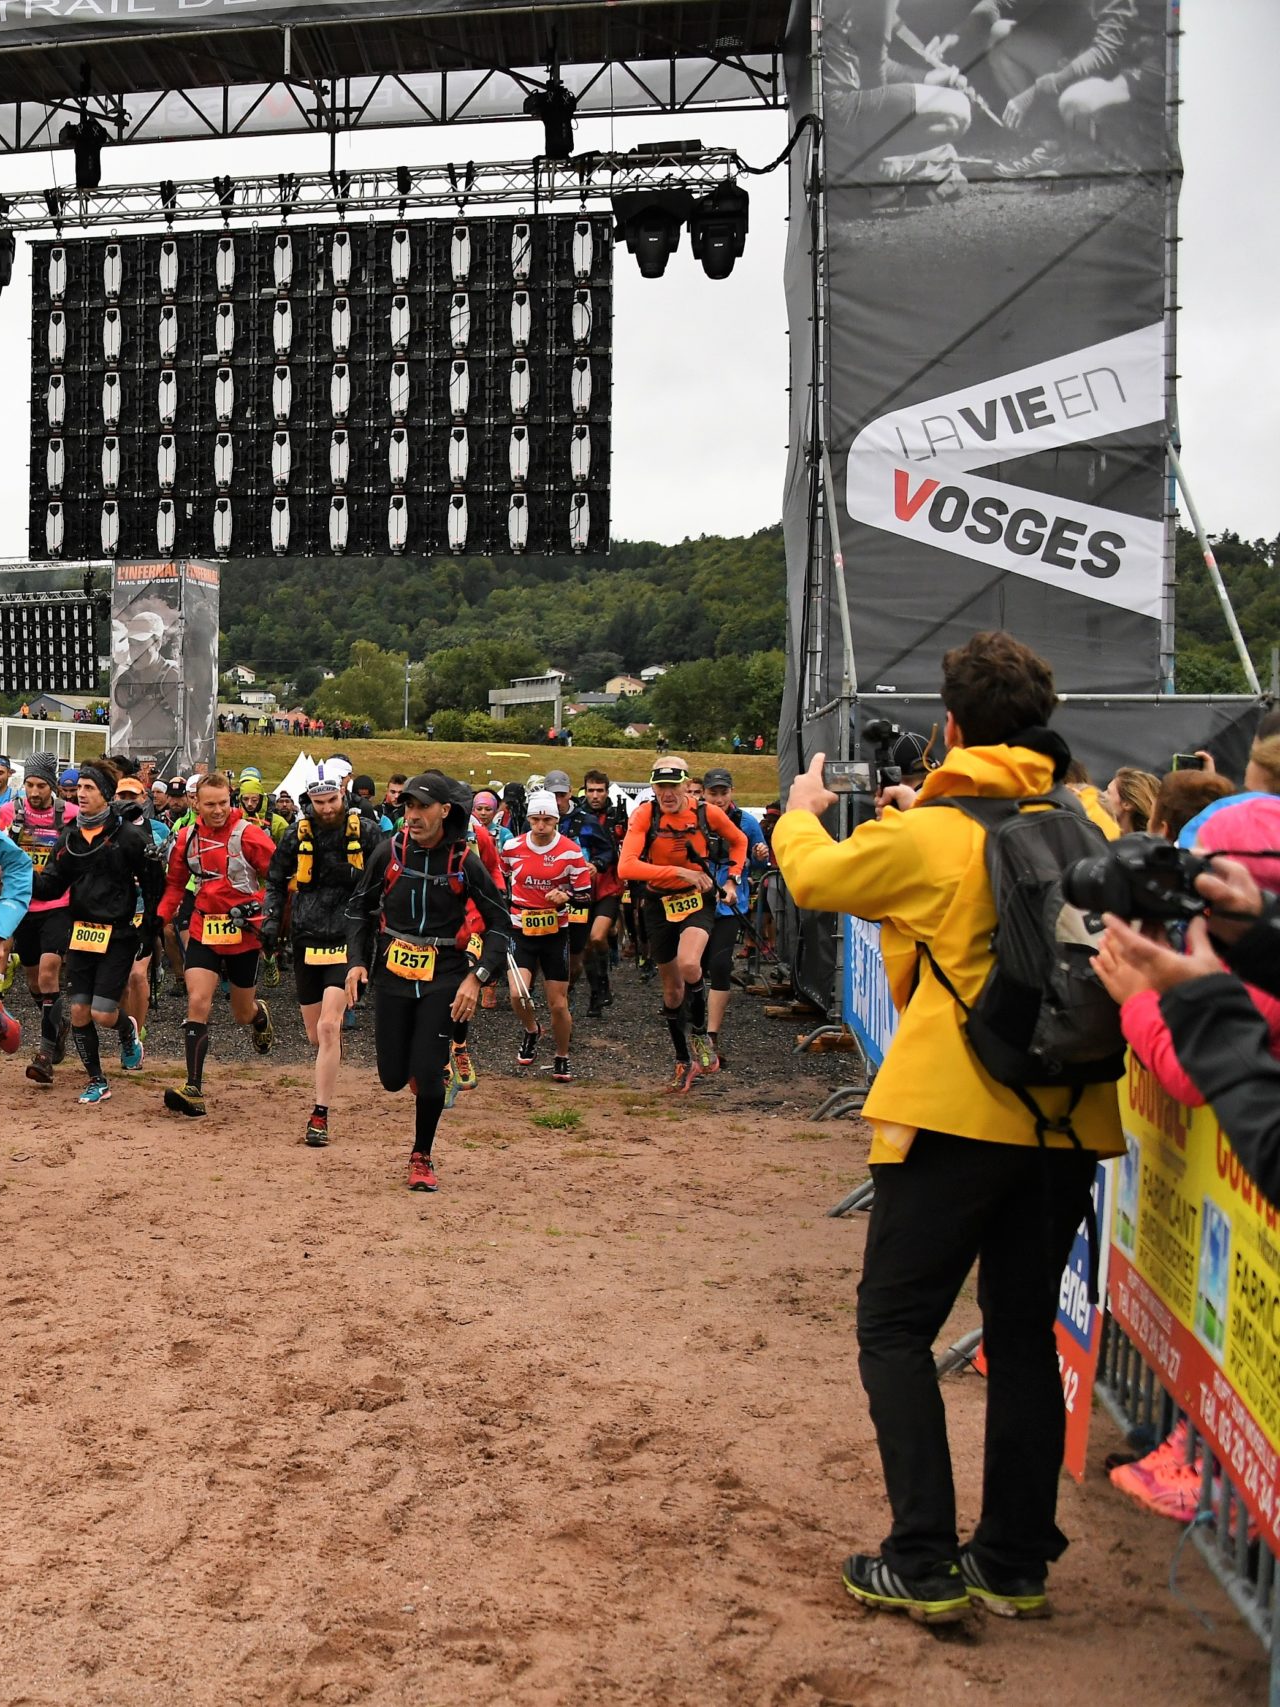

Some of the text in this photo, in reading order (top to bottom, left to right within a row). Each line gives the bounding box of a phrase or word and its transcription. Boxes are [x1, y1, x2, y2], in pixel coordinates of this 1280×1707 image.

[895, 367, 1126, 461] LA VIE EN
[894, 468, 1127, 579] VOSGES
[669, 897, 699, 913] 1338
[525, 915, 555, 928] 8010
[76, 929, 106, 943] 8009
[393, 949, 429, 969] 1257
[1233, 1250, 1280, 1349] FABRIC
